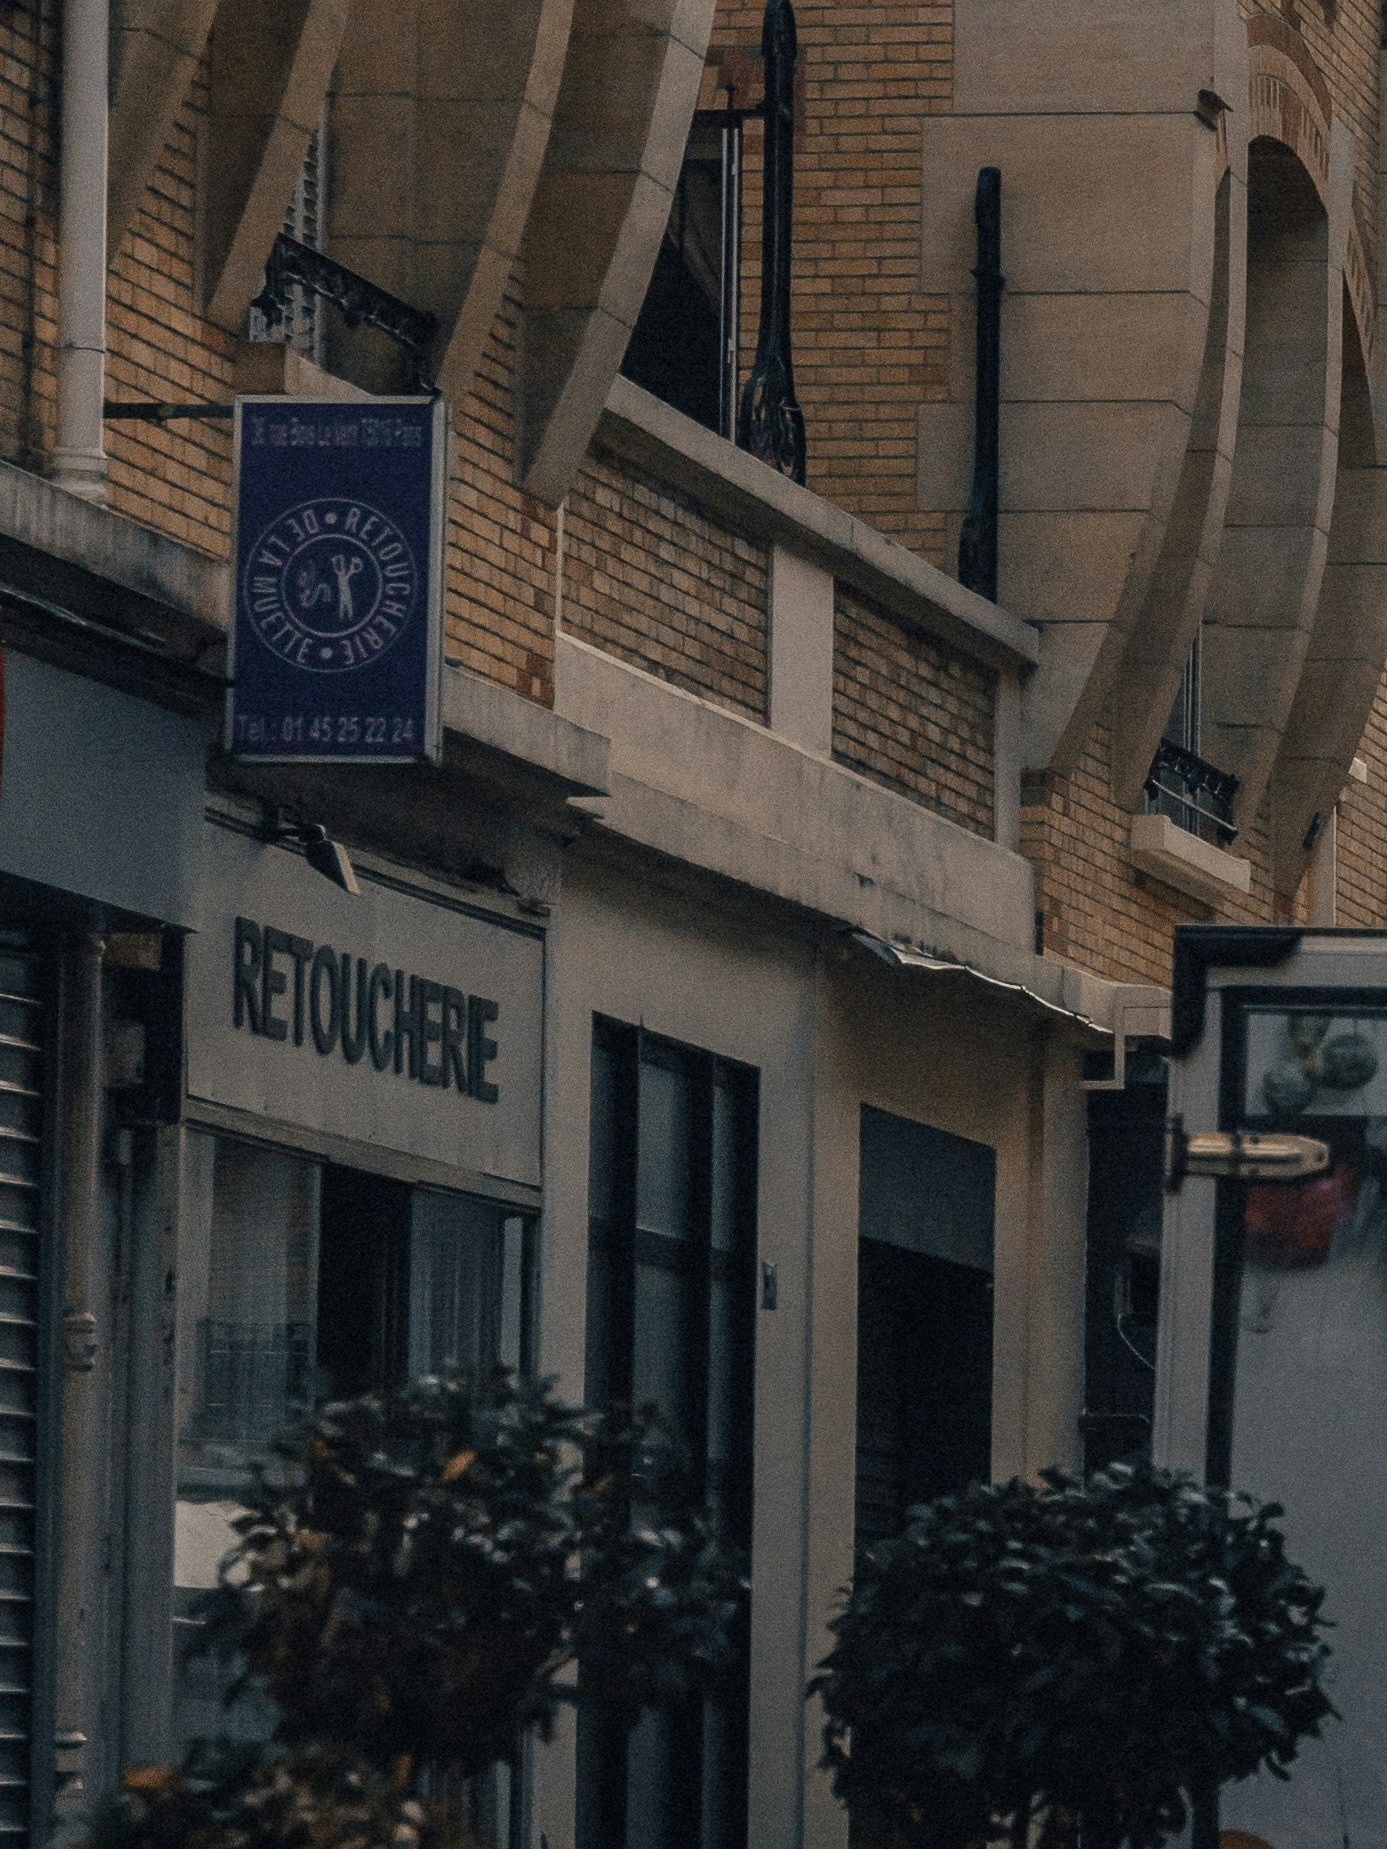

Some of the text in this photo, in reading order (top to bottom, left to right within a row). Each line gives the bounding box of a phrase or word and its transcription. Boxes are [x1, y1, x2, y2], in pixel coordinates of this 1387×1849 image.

[252, 507, 412, 665] RETOUCHERIE DE LA MUETTE
[281, 716, 304, 741] 01
[309, 716, 332, 742] 45
[337, 717, 361, 742] 25
[364, 718, 387, 743] 22
[391, 718, 415, 743] 24
[233, 915, 499, 1105] RETOUCHERIE
